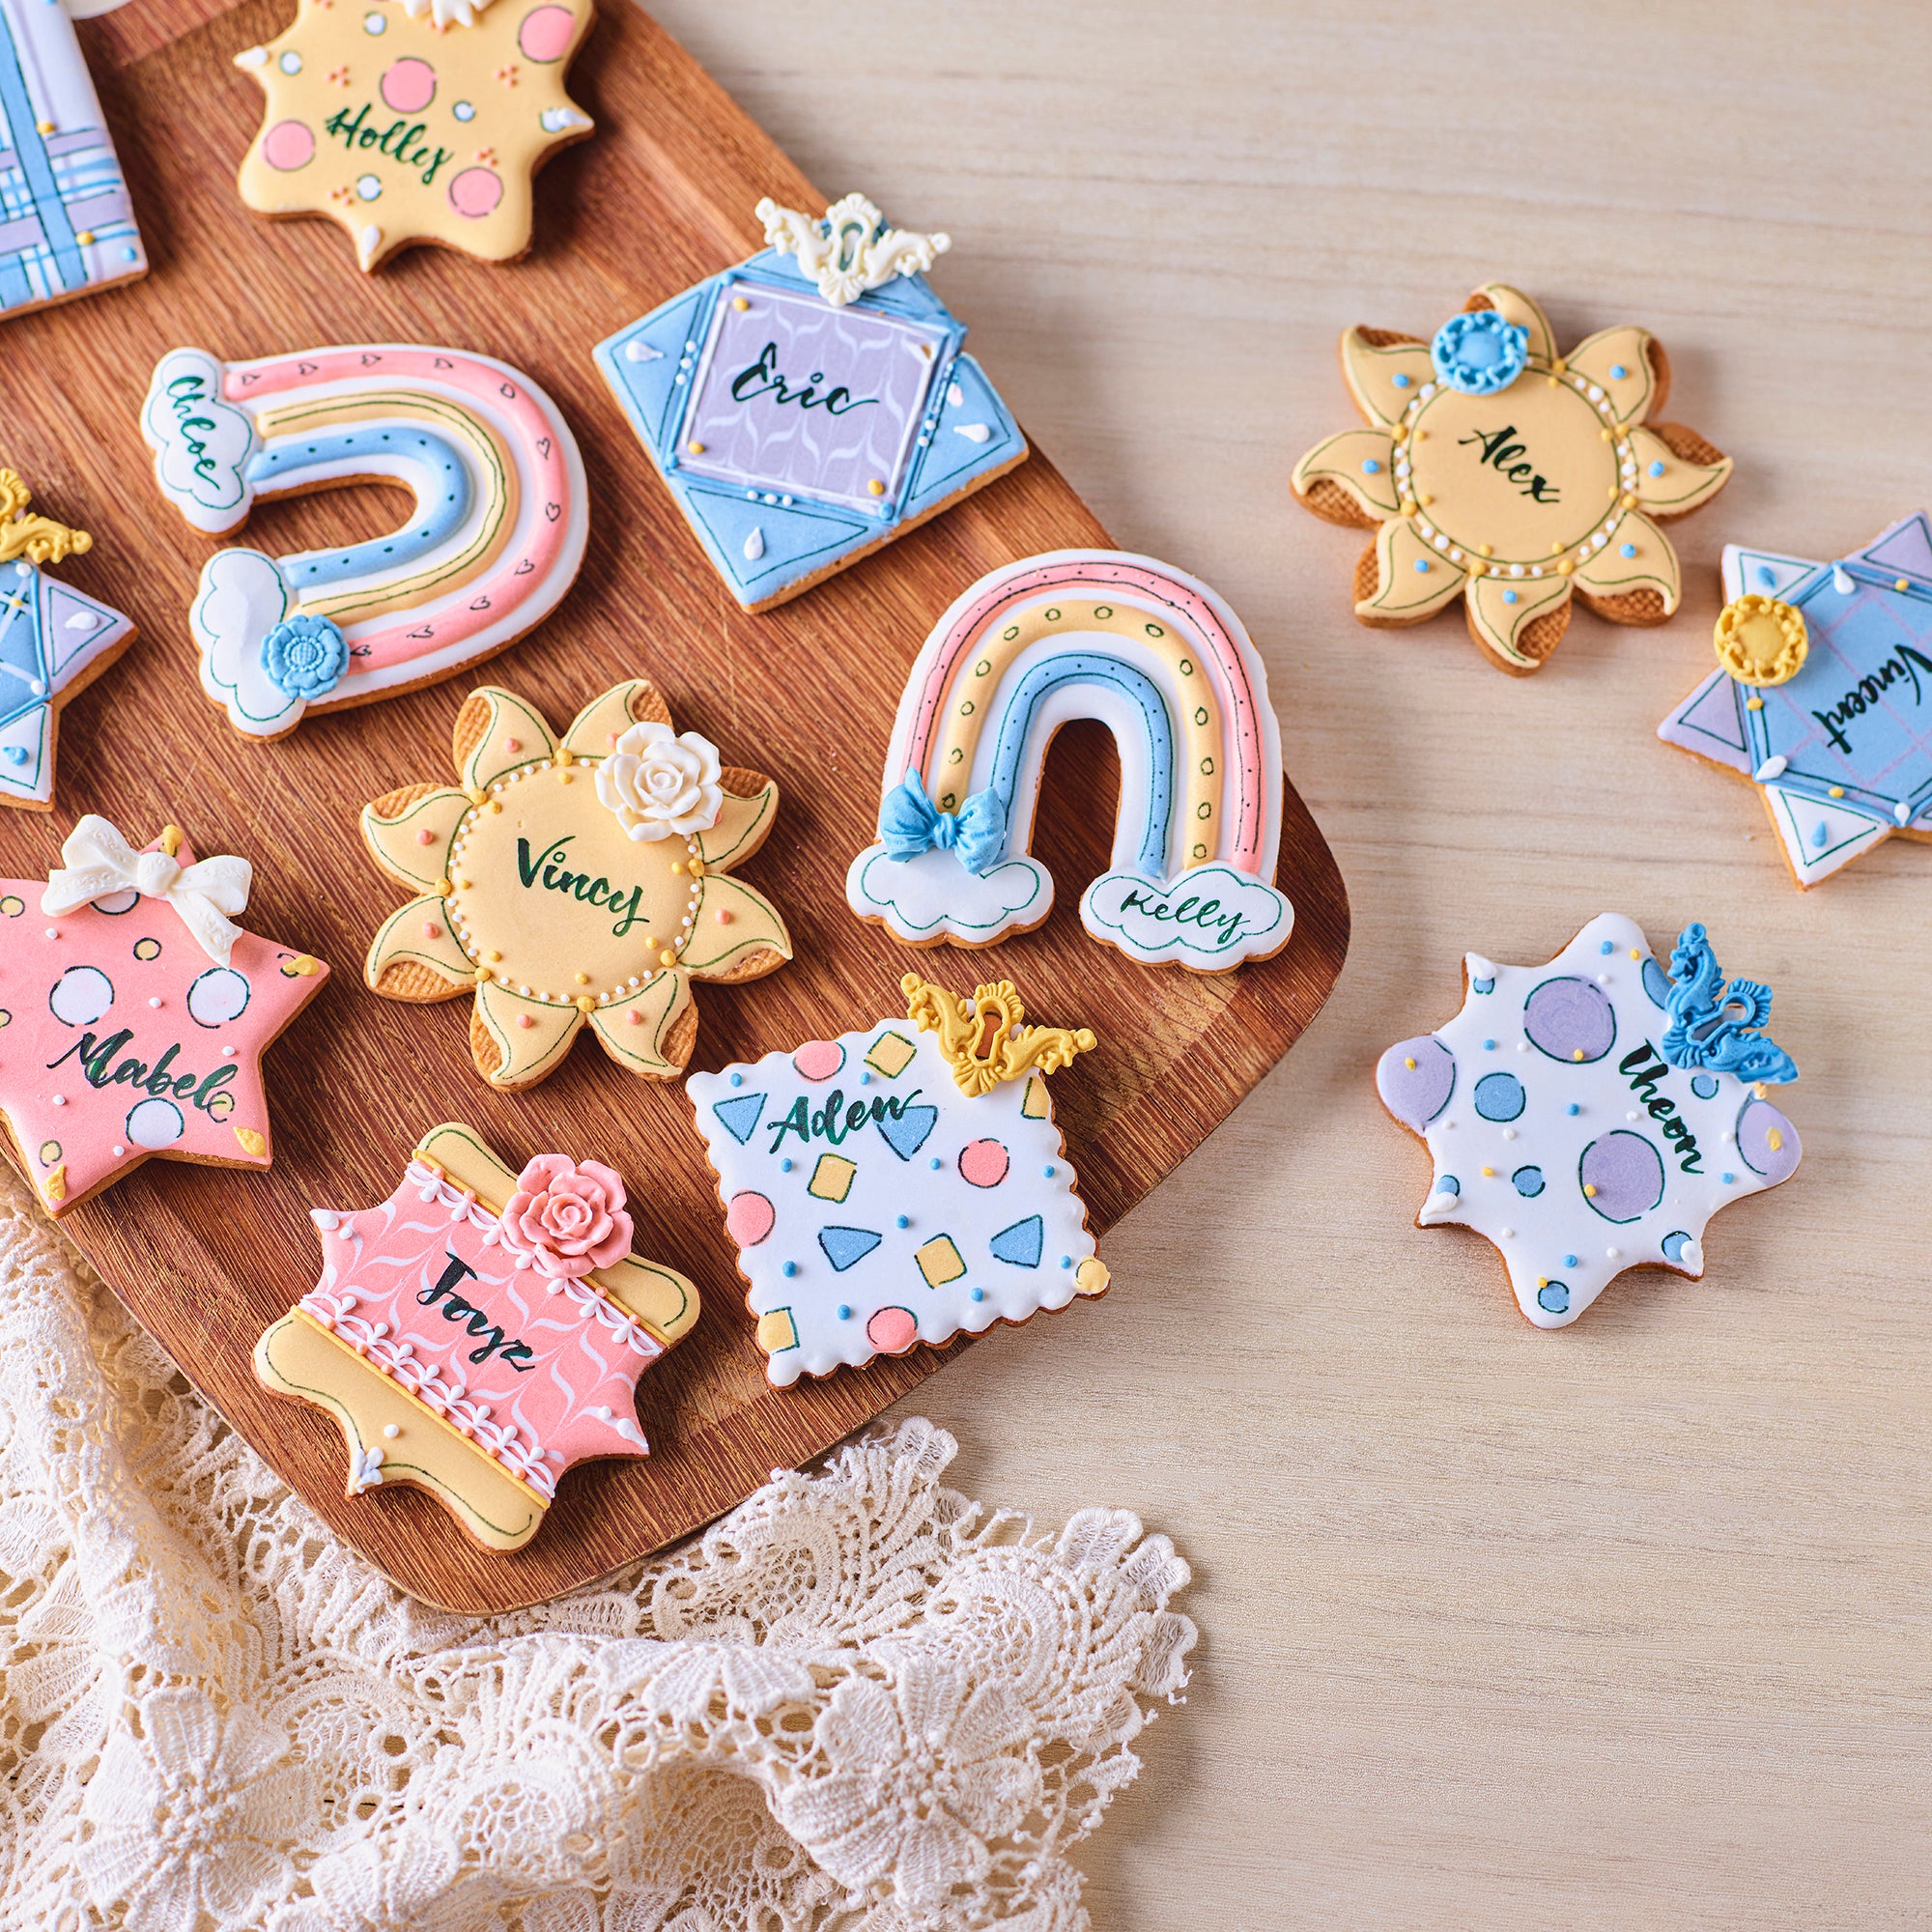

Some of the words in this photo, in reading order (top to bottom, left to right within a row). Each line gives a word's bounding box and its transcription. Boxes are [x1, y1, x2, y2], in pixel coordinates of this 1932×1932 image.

[731, 342, 881, 415] Eric
[167, 376, 220, 491] Chloe
[1458, 425, 1560, 503] Alex
[1811, 643, 1932, 754] Vincent
[517, 836, 650, 937] Vincy
[1120, 890, 1251, 945] Kelly
[46, 1029, 239, 1110] Mabel
[1619, 1038, 1704, 1174] Theon
[766, 1089, 923, 1154] Aden
